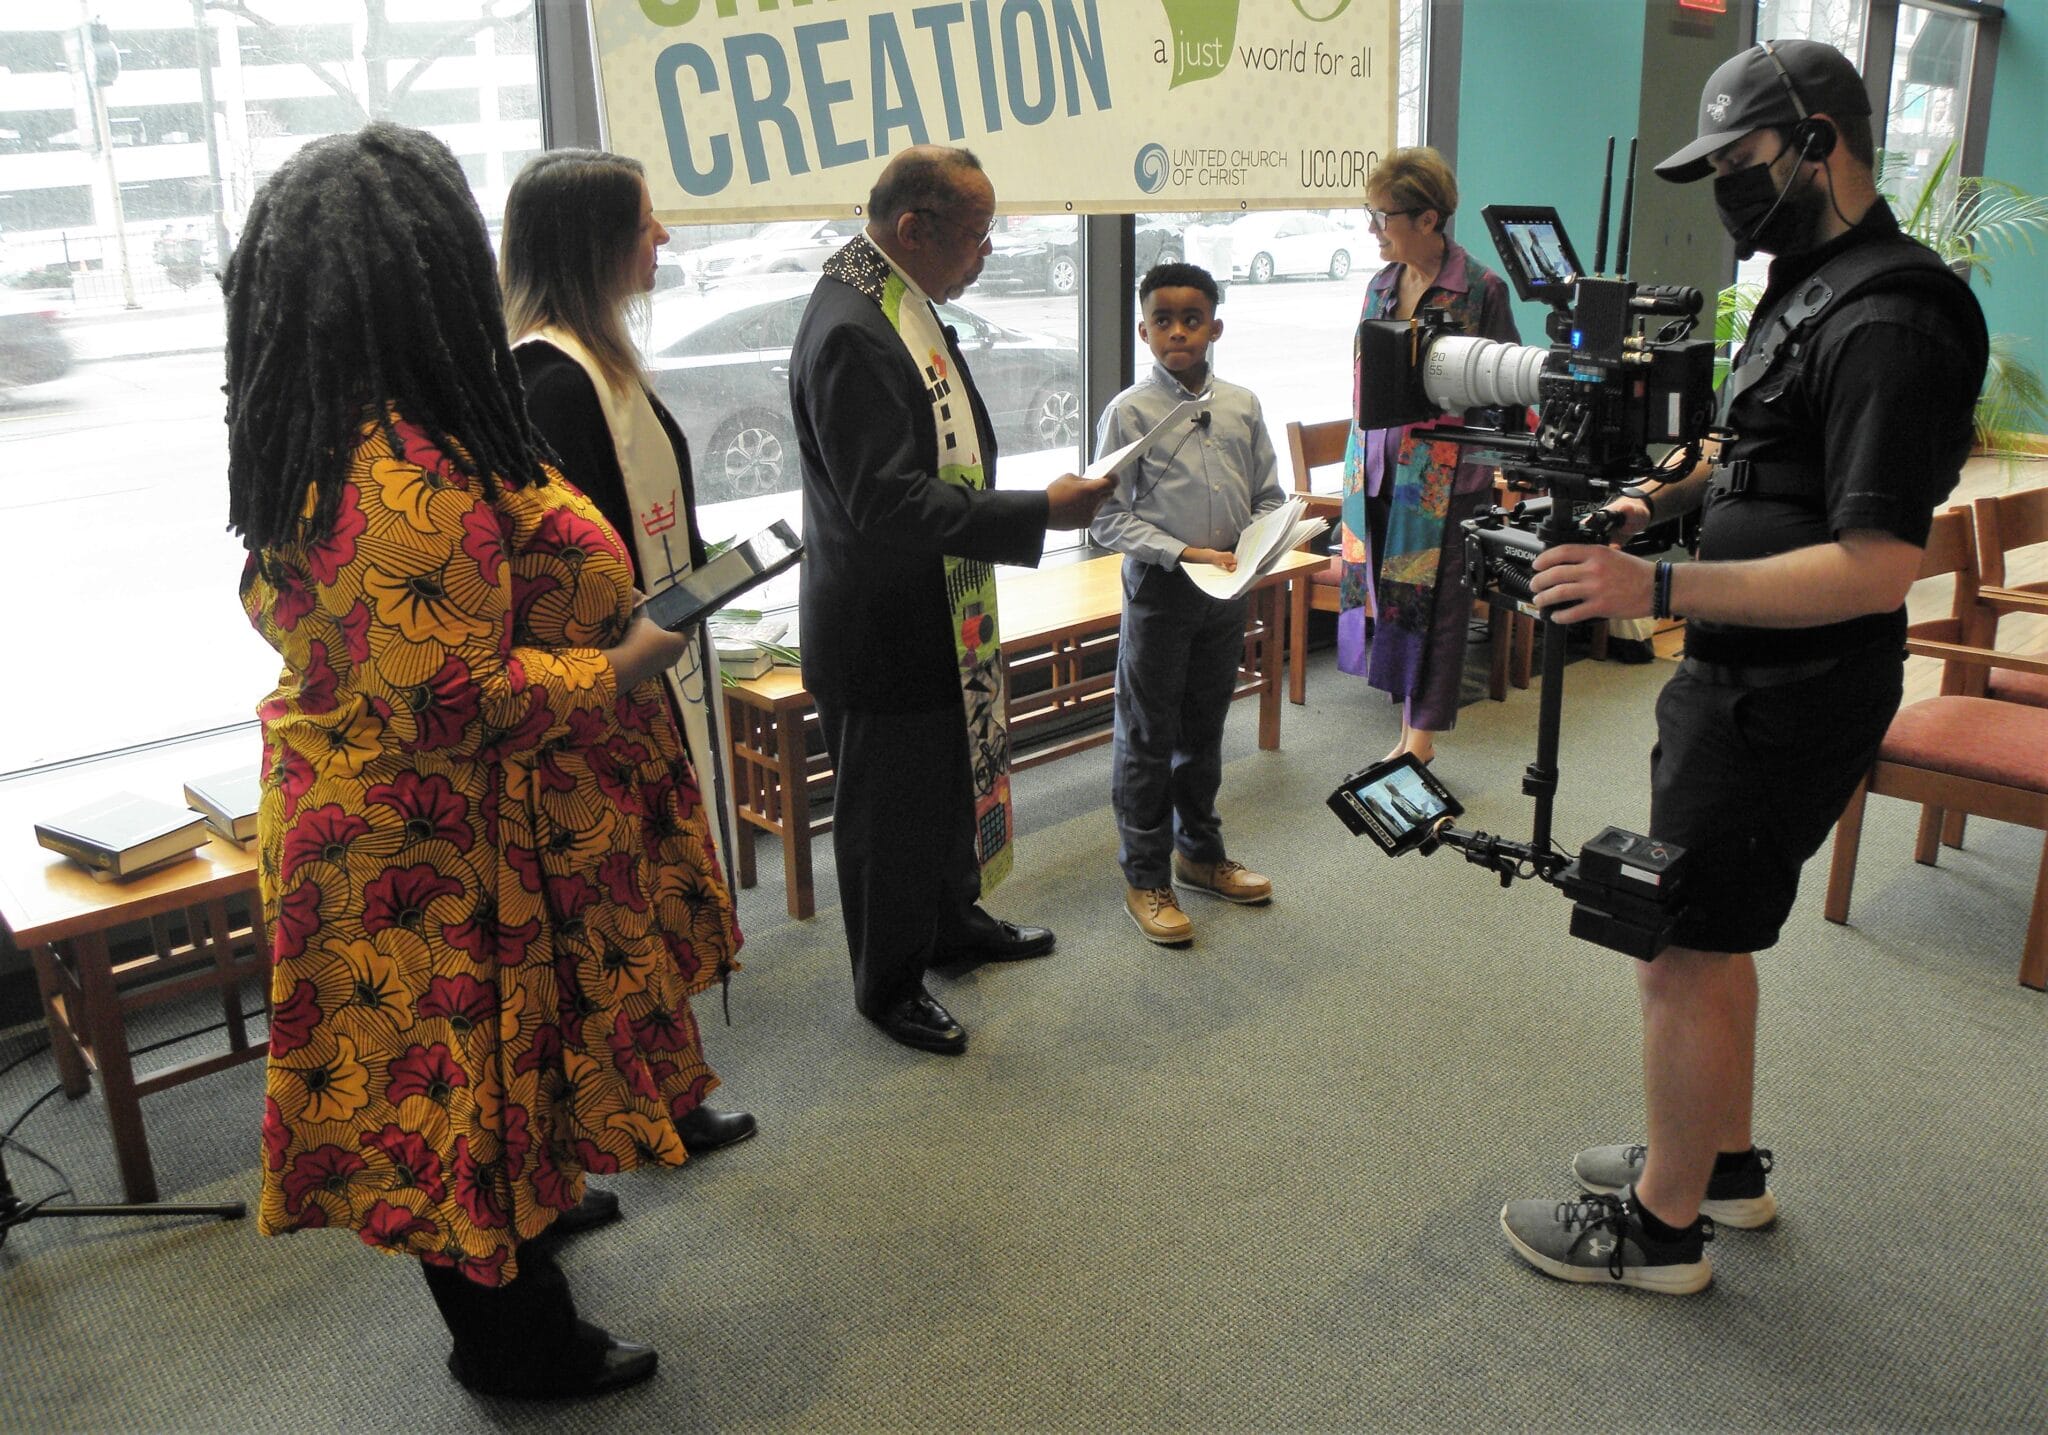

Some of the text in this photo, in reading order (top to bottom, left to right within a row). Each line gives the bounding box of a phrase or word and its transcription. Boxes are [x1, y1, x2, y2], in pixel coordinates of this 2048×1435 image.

[1154, 29, 1371, 78] a just world for all
[654, 0, 1112, 197] CREATION
[1173, 149, 1287, 167] UNITED CHURCH
[1172, 168, 1248, 186] OF CHRIST
[1431, 352, 1445, 361] 20
[1429, 365, 1443, 376] 55
